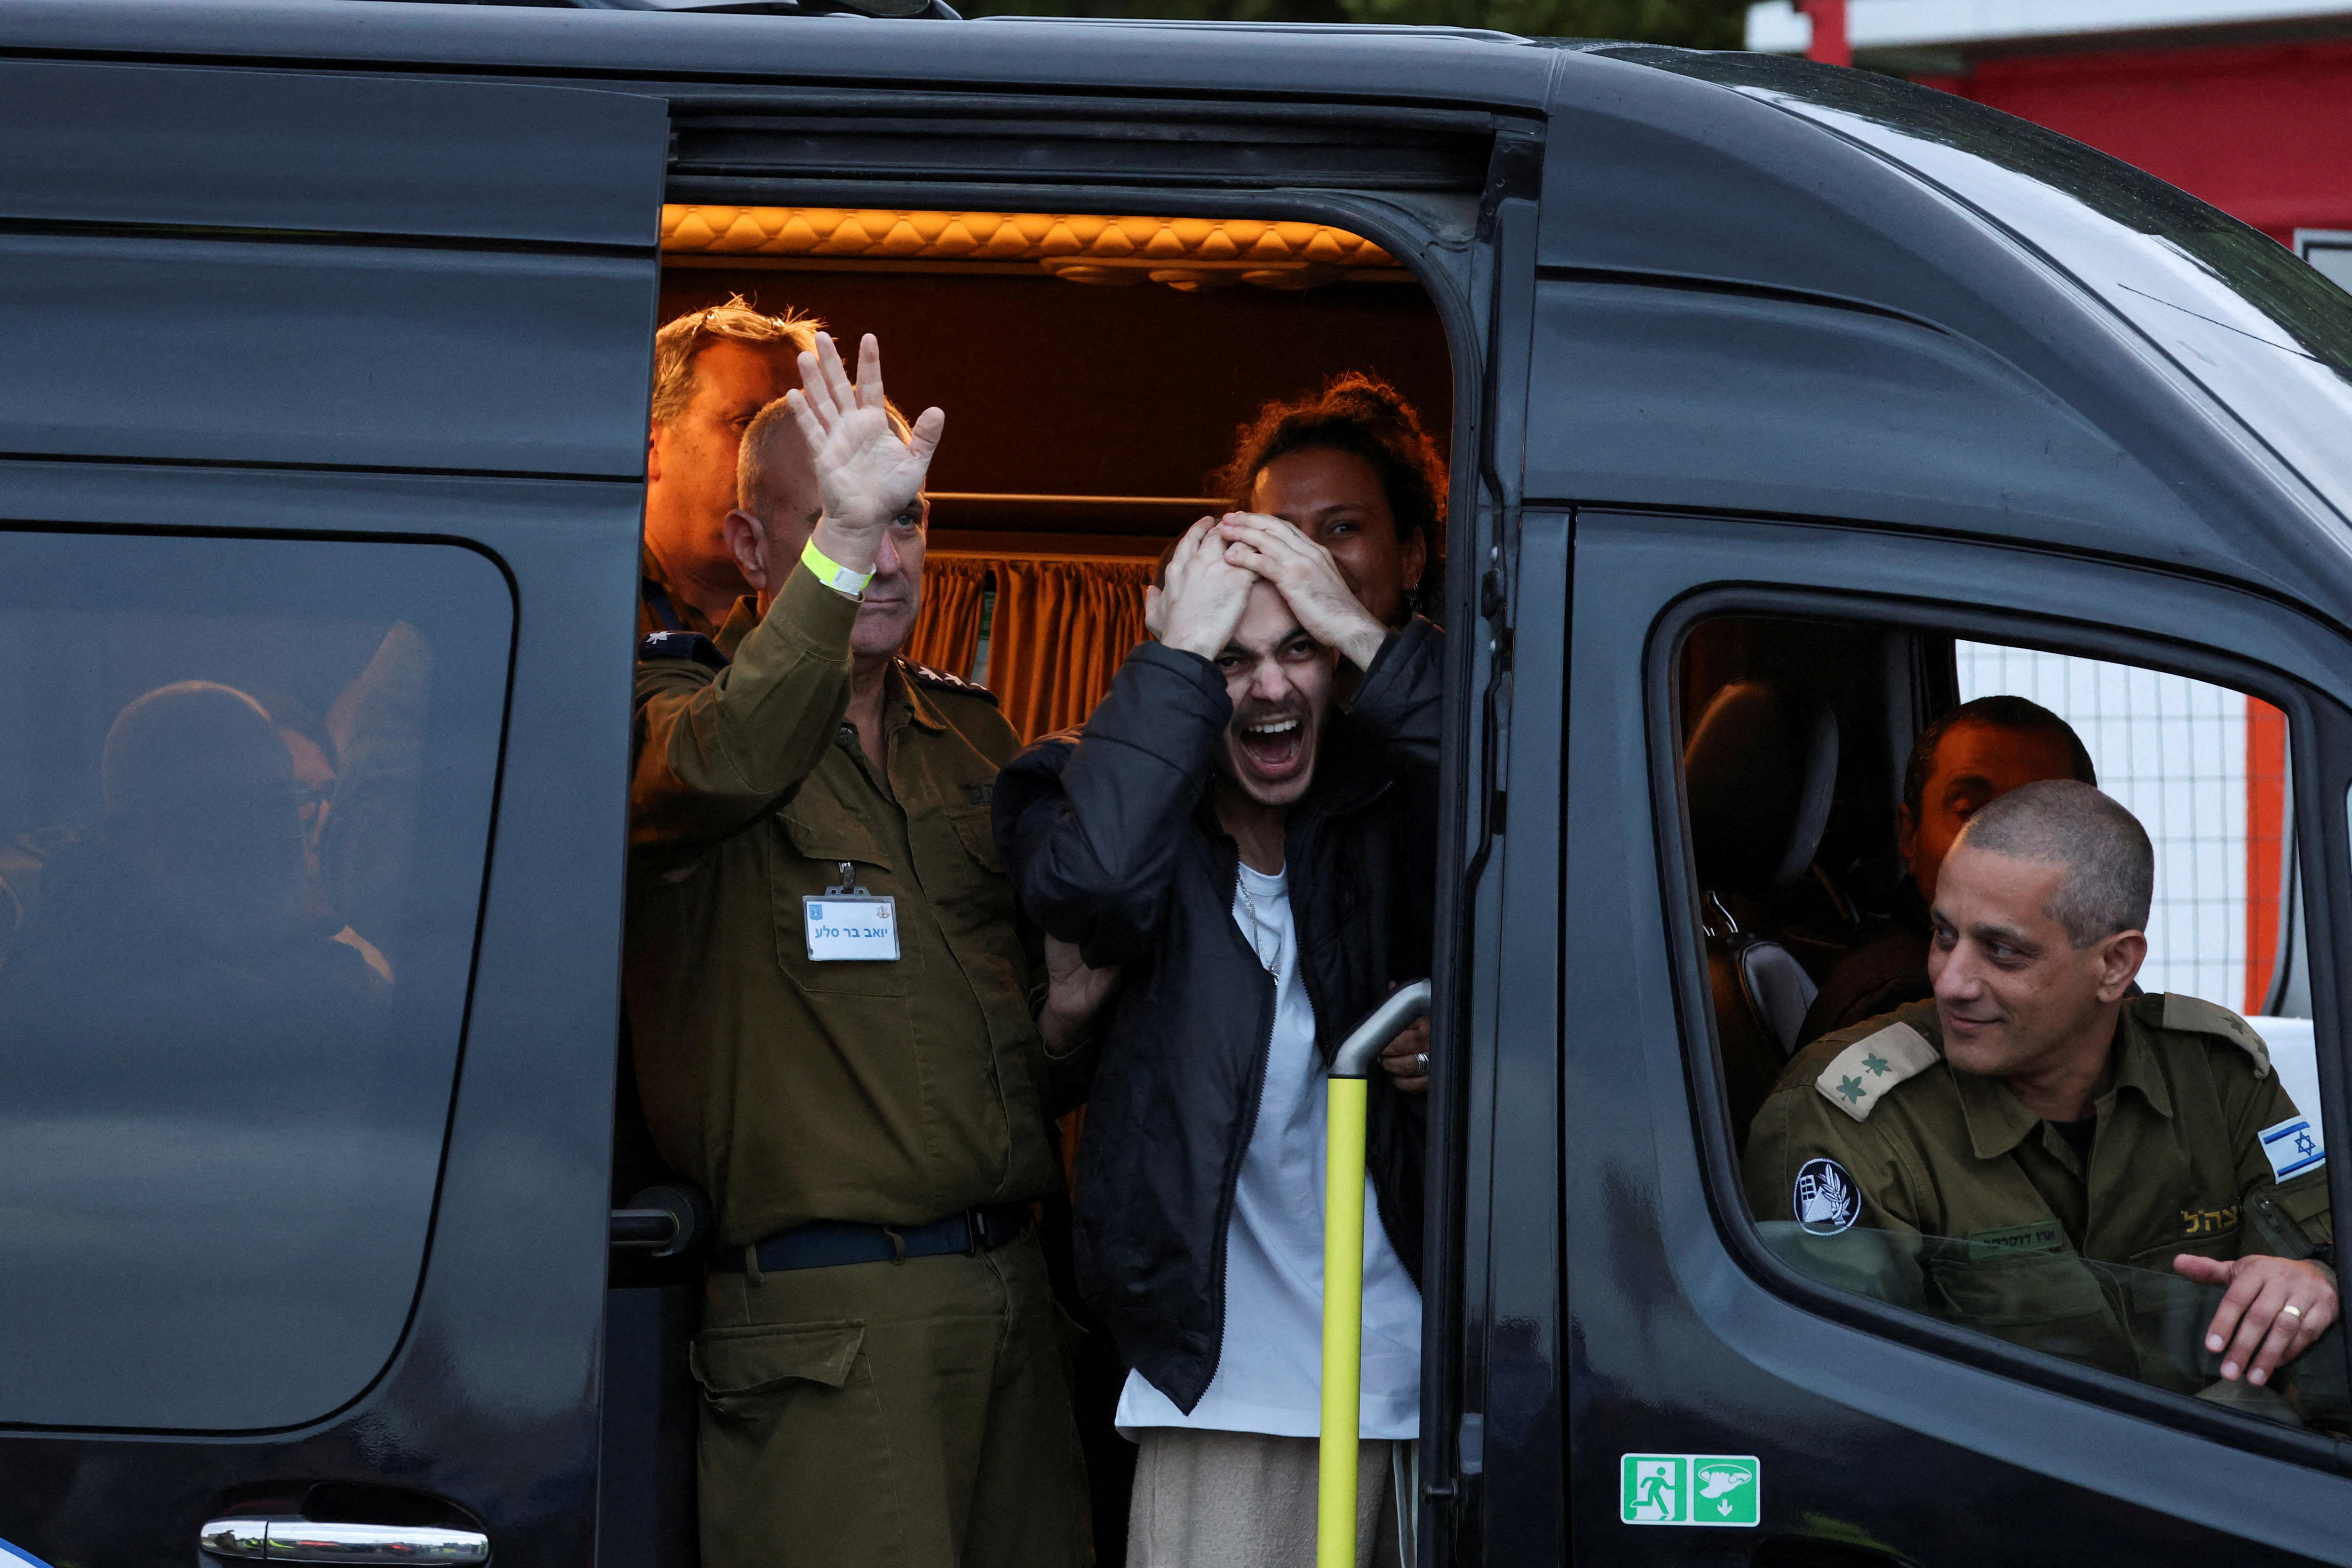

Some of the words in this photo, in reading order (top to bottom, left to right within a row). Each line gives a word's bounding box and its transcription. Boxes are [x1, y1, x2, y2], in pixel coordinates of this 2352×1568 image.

[815, 925, 840, 939] סלע
[843, 928, 860, 938] בר
[864, 928, 888, 938] יואב
